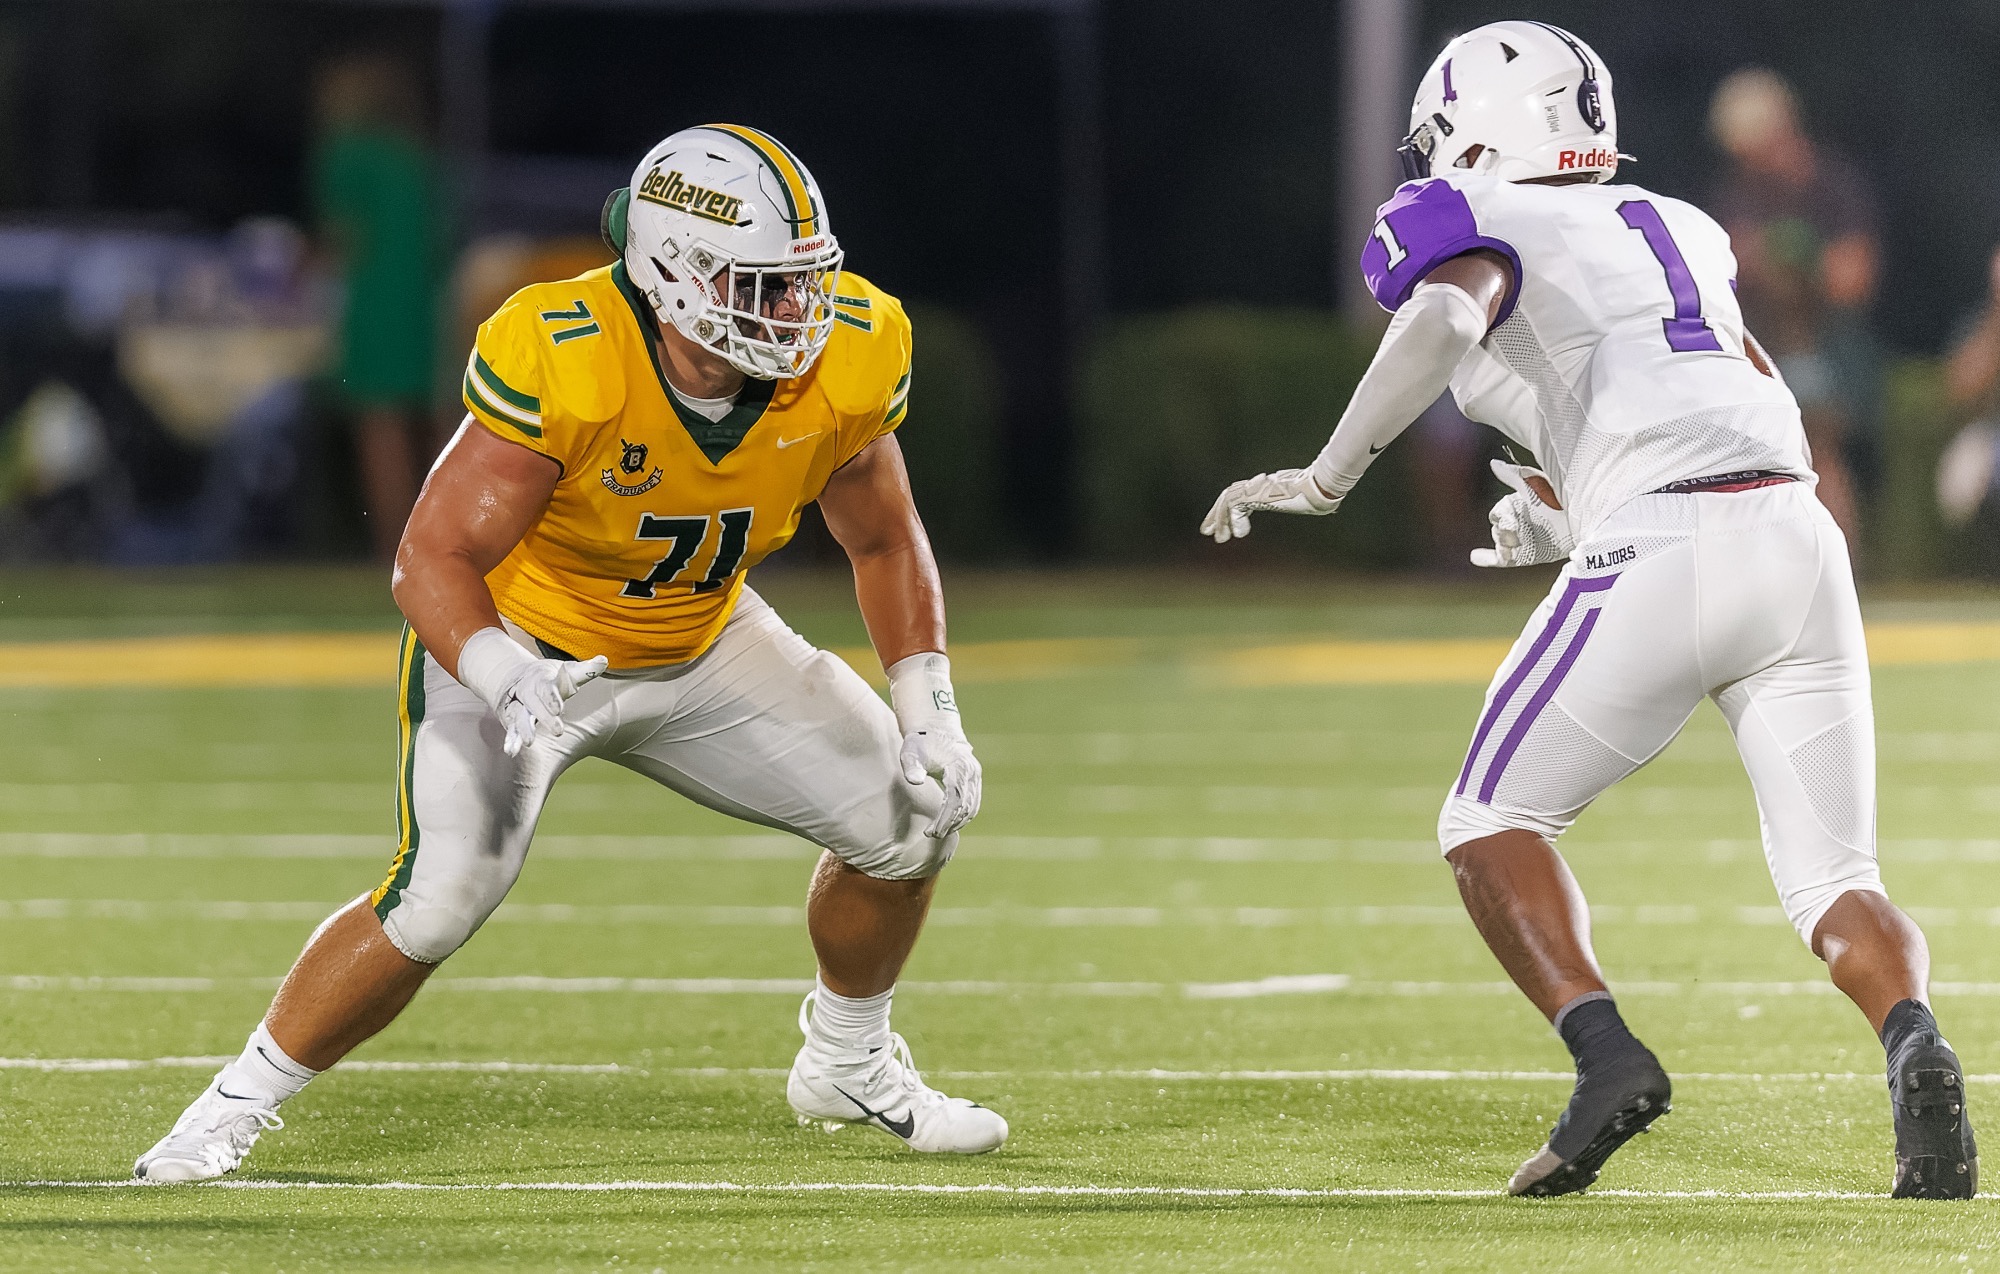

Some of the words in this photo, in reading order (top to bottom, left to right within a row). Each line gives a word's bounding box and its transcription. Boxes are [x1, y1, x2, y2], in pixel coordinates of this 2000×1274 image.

[1440, 57, 1458, 107] 1
[1558, 148, 1618, 170] Riddel
[639, 166, 744, 220] Belhaven
[793, 239, 825, 254] Riddell
[1373, 215, 1408, 275] 1
[1615, 200, 1723, 352] 1
[540, 299, 602, 347] 71
[629, 451, 641, 467] B
[605, 479, 656, 495] GRADUATE
[618, 506, 754, 600] 71
[1585, 545, 1637, 570] MAJORS
